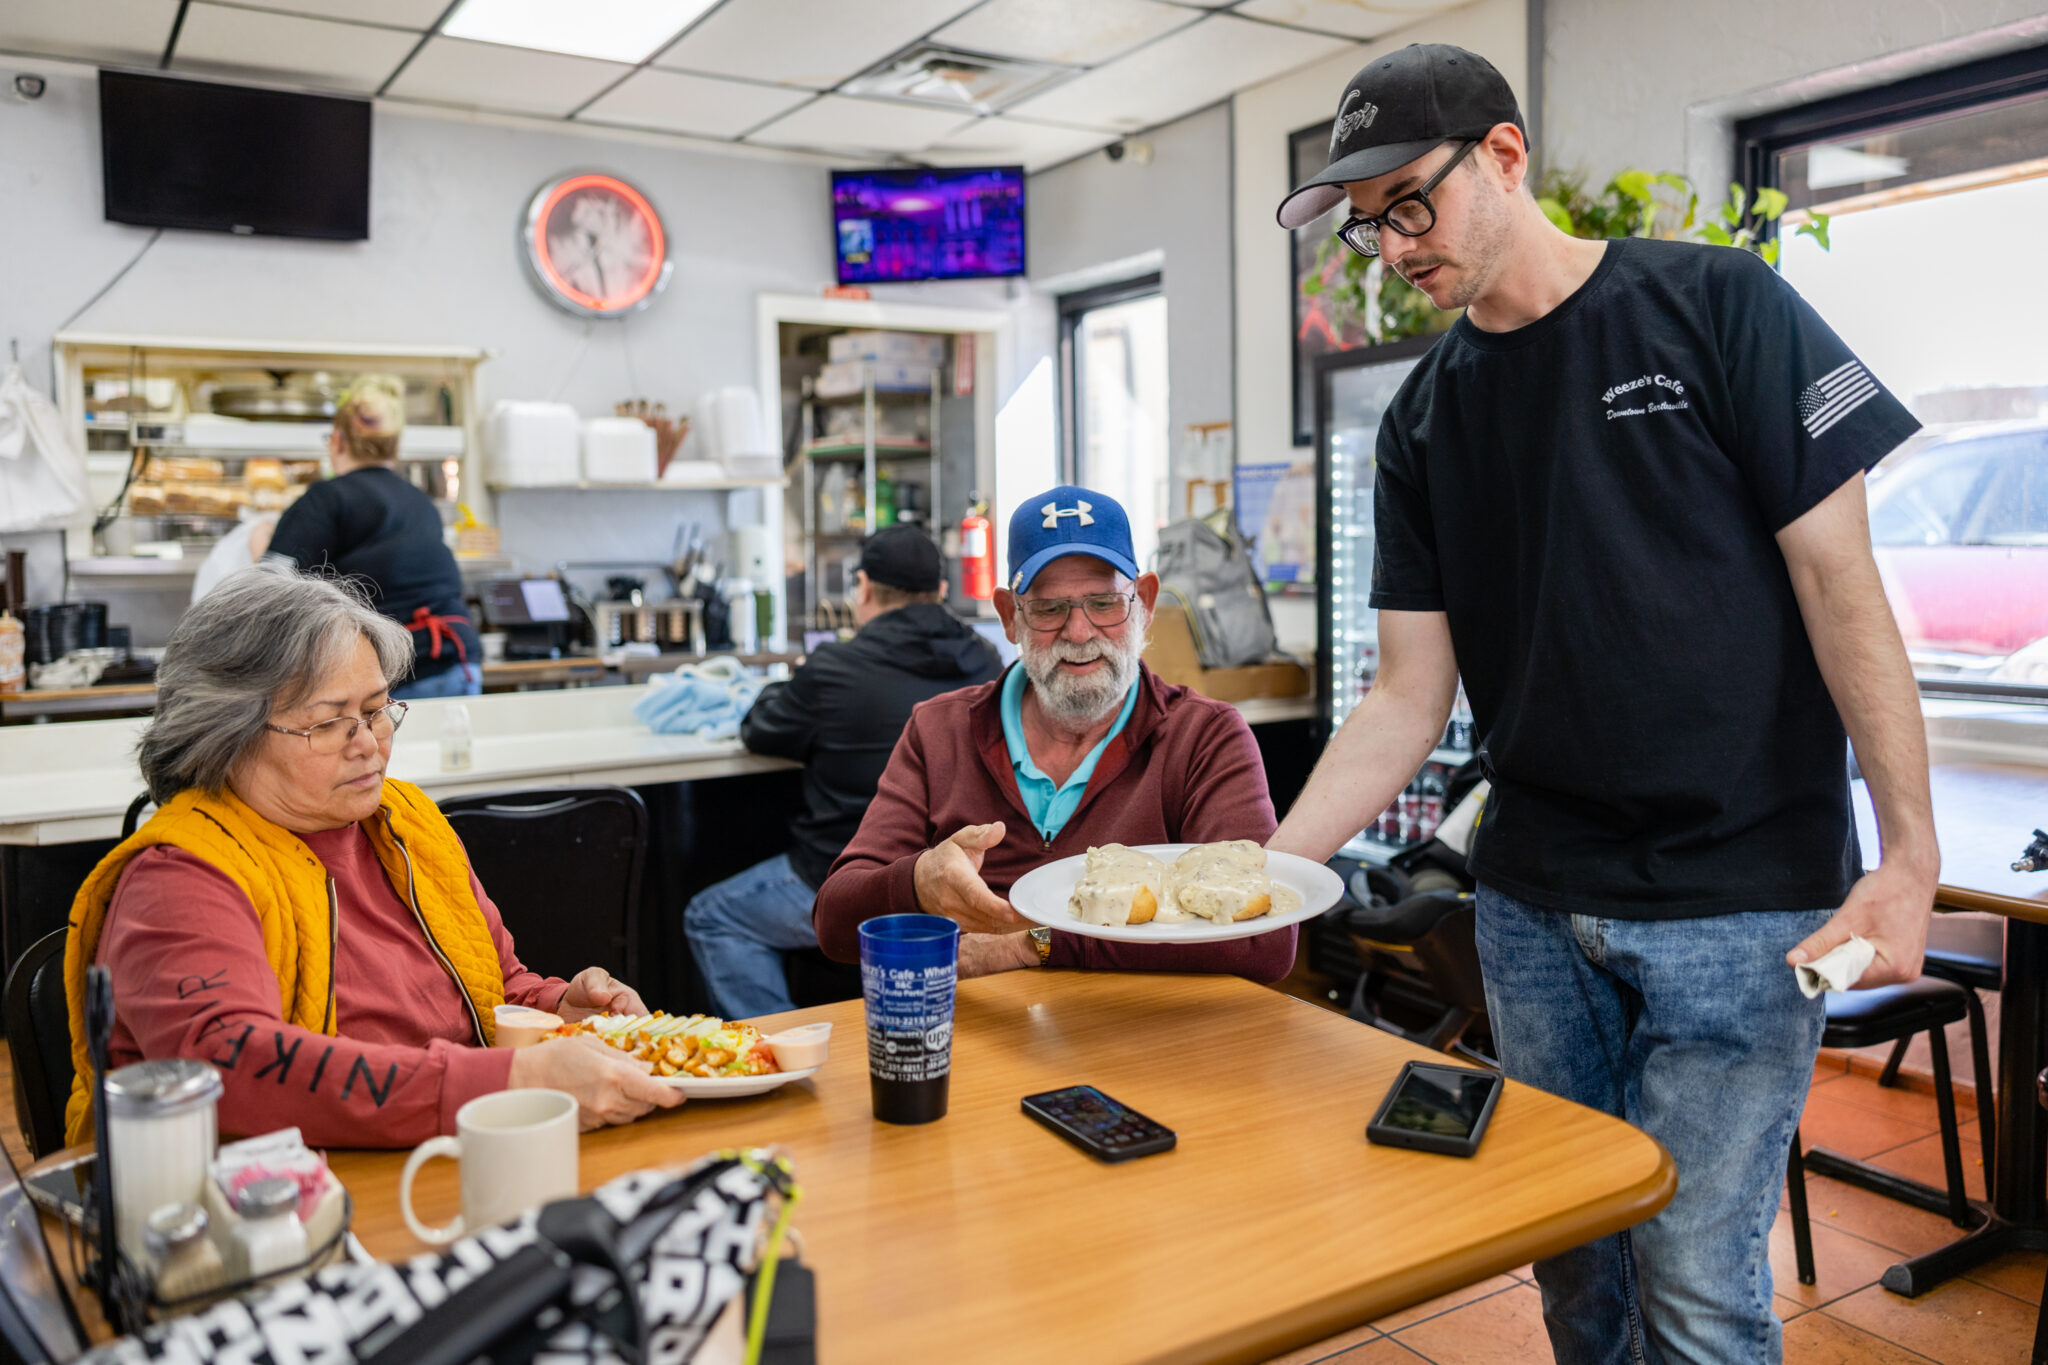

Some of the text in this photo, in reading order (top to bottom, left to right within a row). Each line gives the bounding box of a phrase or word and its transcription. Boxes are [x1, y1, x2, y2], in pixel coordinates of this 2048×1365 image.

[1601, 374, 1685, 404] Weeze's Cafe
[1606, 407, 1645, 420] Downtown
[889, 968, 915, 980] Cafe
[928, 1029, 950, 1046] ups
[211, 1024, 398, 1108] NIKE
